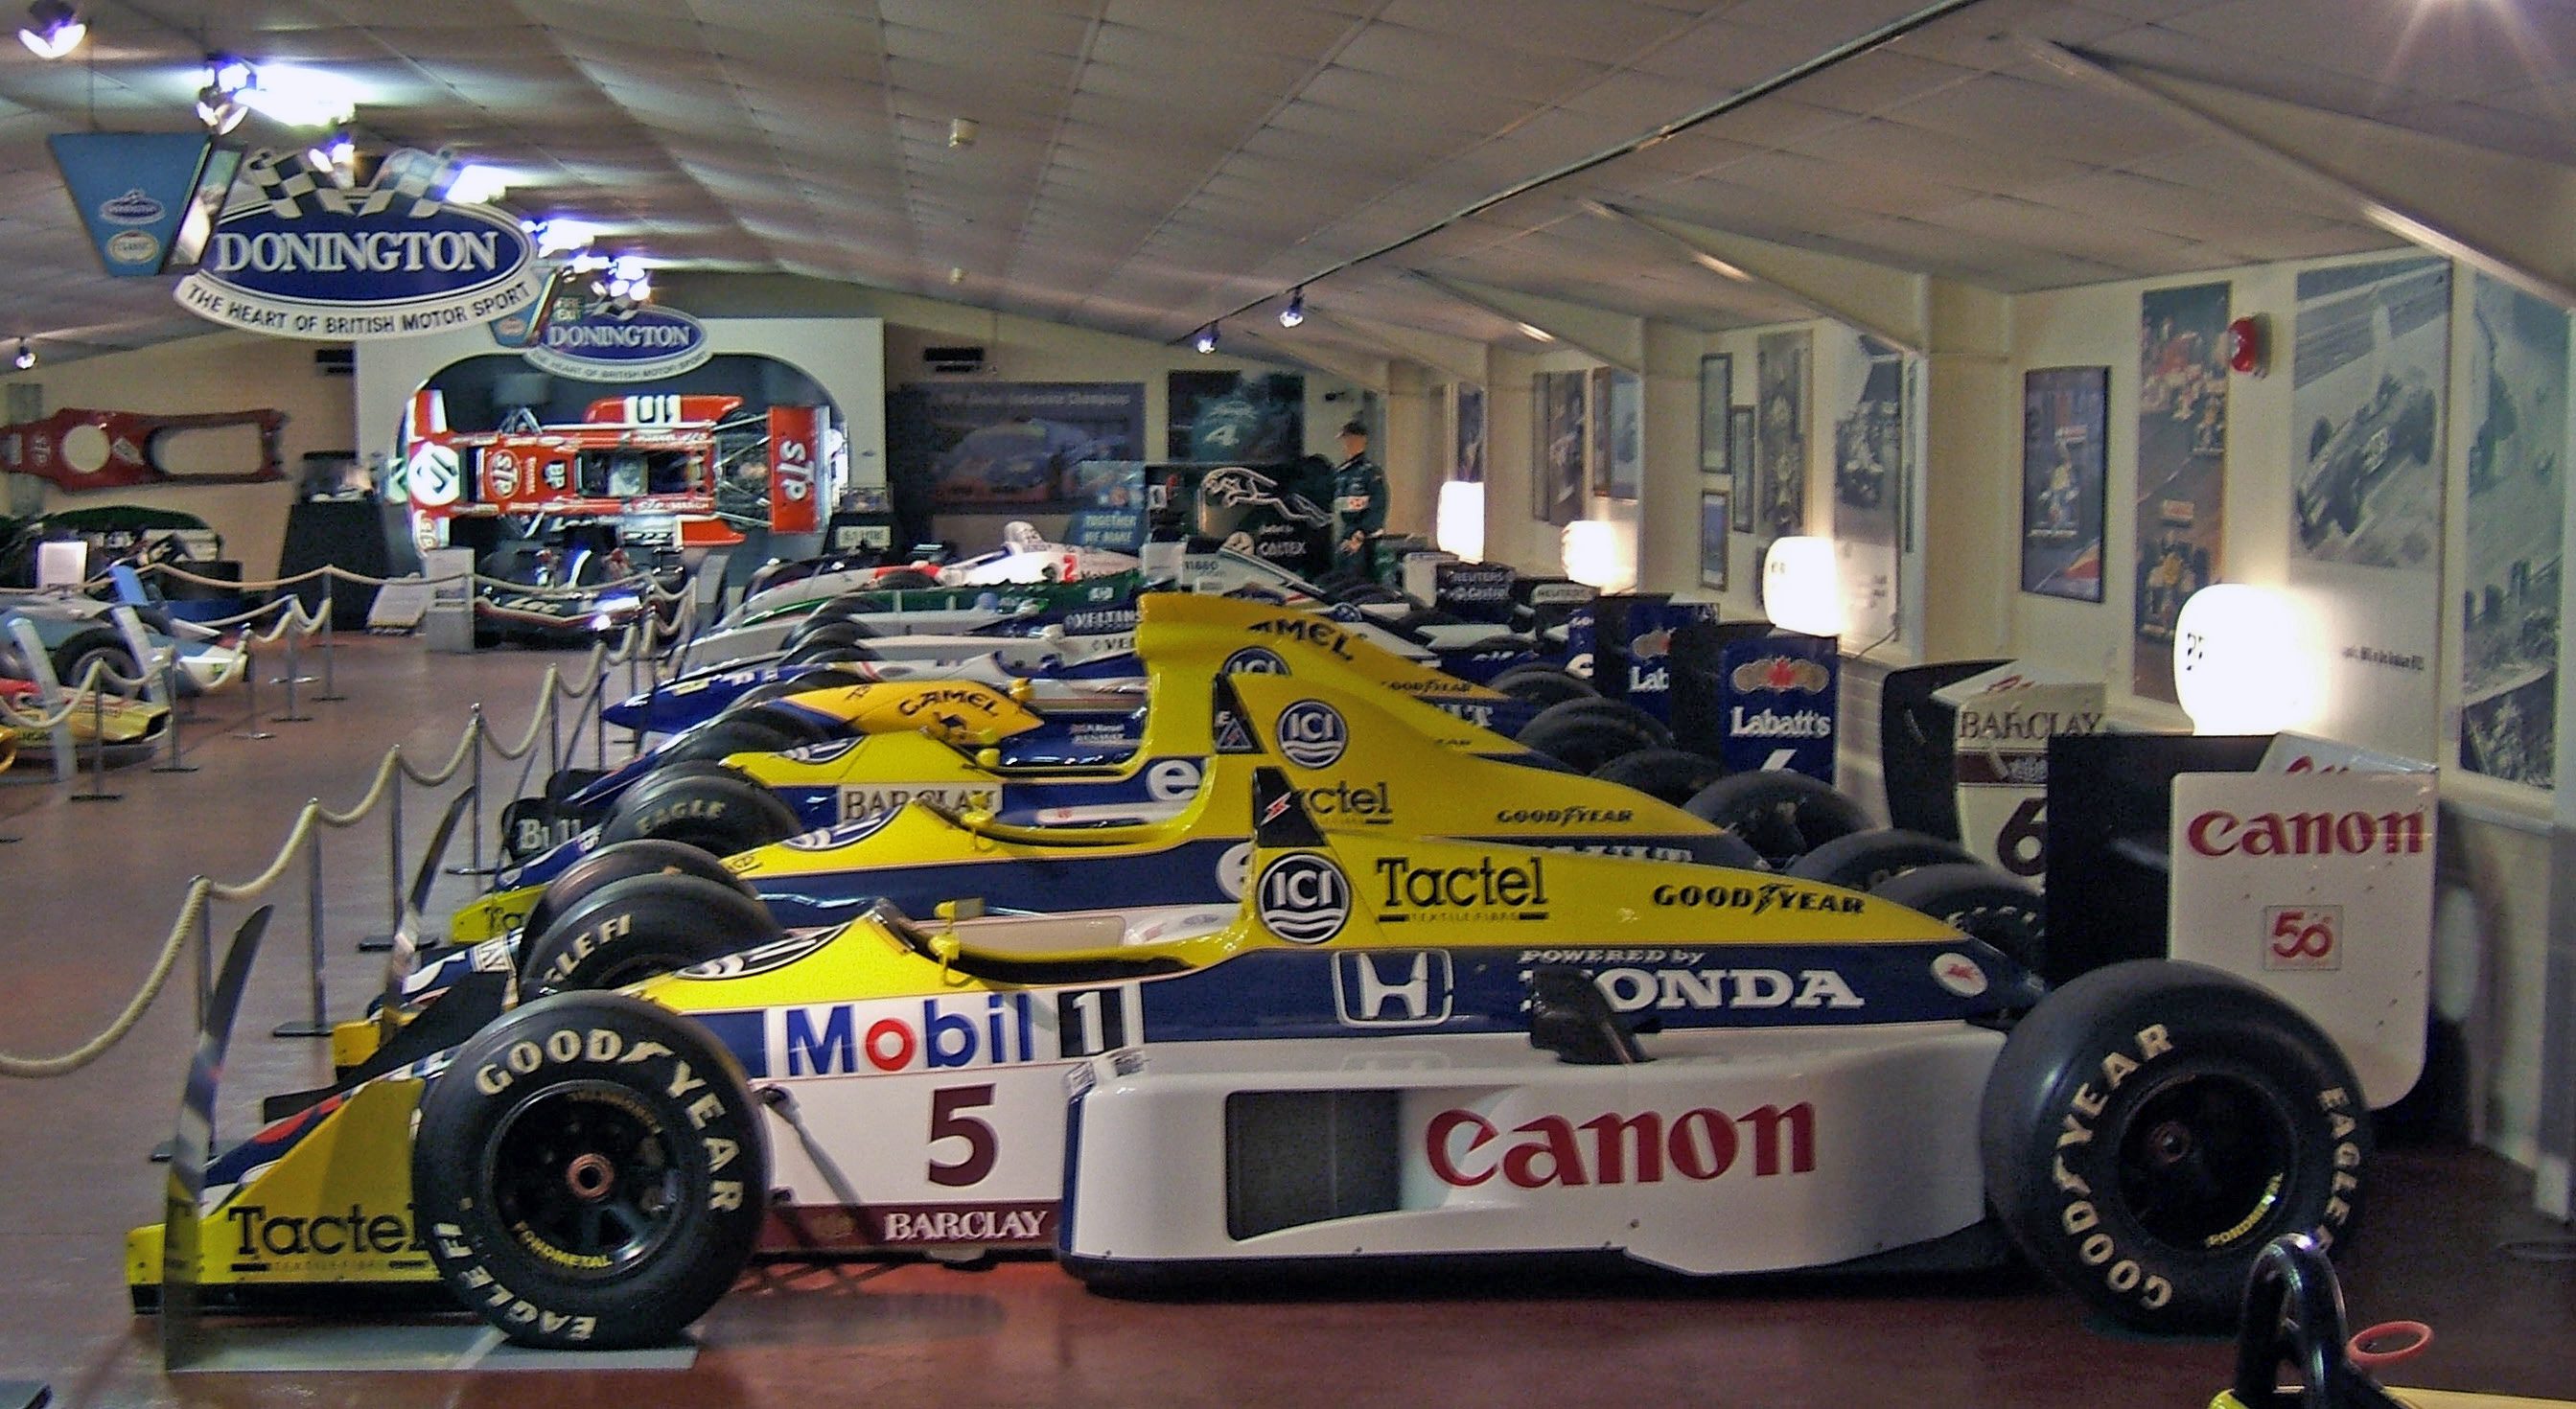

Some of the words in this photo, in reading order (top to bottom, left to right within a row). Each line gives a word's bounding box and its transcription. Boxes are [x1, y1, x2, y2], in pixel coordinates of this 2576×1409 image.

[213, 231, 499, 272] DONINGTON
[187, 285, 221, 312] THE
[228, 302, 289, 330] HEART
[295, 314, 317, 332] OF
[327, 315, 395, 333] BRITISH
[403, 305, 468, 332] MOTOR
[476, 281, 532, 316] SPORT
[546, 325, 691, 348] DONINGTON
[551, 360, 583, 373] HEART
[587, 369, 599, 378] OF
[602, 369, 641, 379] BRITISH
[643, 365, 677, 378] MOTOR
[679, 352, 708, 369] SPORT
[491, 454, 519, 497] STP
[776, 439, 815, 501] STP
[1062, 554, 1078, 583] 2
[1258, 541, 1307, 557] CALTEX
[1247, 618, 1355, 661] AMEL
[897, 688, 1001, 717] CAMEL
[1729, 705, 1832, 739] Labatt's
[1288, 711, 1334, 741] ICI
[637, 799, 727, 832] EAGLE
[1496, 804, 1634, 826] GOODYEAR
[2187, 808, 2428, 857] Canon
[1272, 869, 1333, 909] ICI
[1376, 854, 1549, 908] Tactel
[1653, 882, 1866, 914] GOODYEAR
[2272, 911, 2333, 959] 50
[1517, 949, 1666, 964] POWERED
[1669, 949, 1706, 966] by
[1519, 967, 1866, 1013] ONDA
[785, 991, 1034, 1076] Mobil
[1072, 990, 1105, 1054] 1
[927, 1083, 999, 1187] 5
[1426, 1100, 1818, 1189] Canon
[228, 1203, 429, 1256] Tacte
[884, 1210, 1048, 1241] BARCLAY
